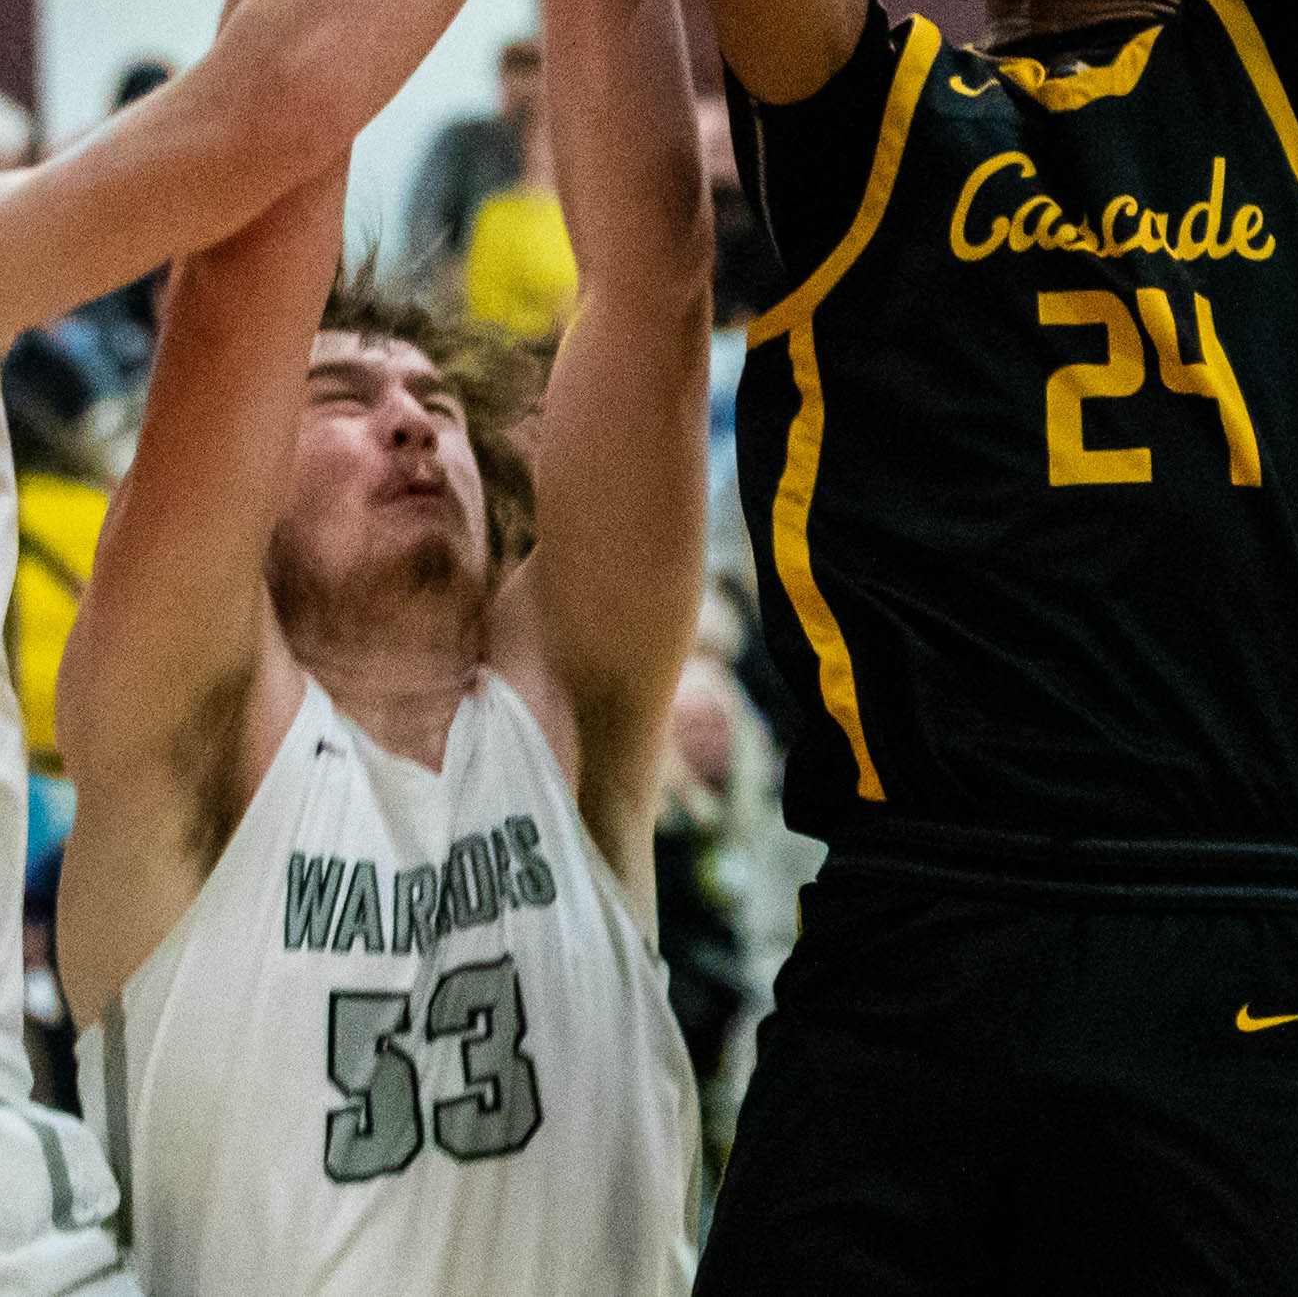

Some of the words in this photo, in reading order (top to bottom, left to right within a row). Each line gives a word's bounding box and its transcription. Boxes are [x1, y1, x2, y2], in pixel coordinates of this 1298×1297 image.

[950, 151, 1276, 262] Cascade
[1037, 288, 1263, 488] 24
[284, 813, 557, 957] WARORS
[324, 952, 545, 1184] 53
